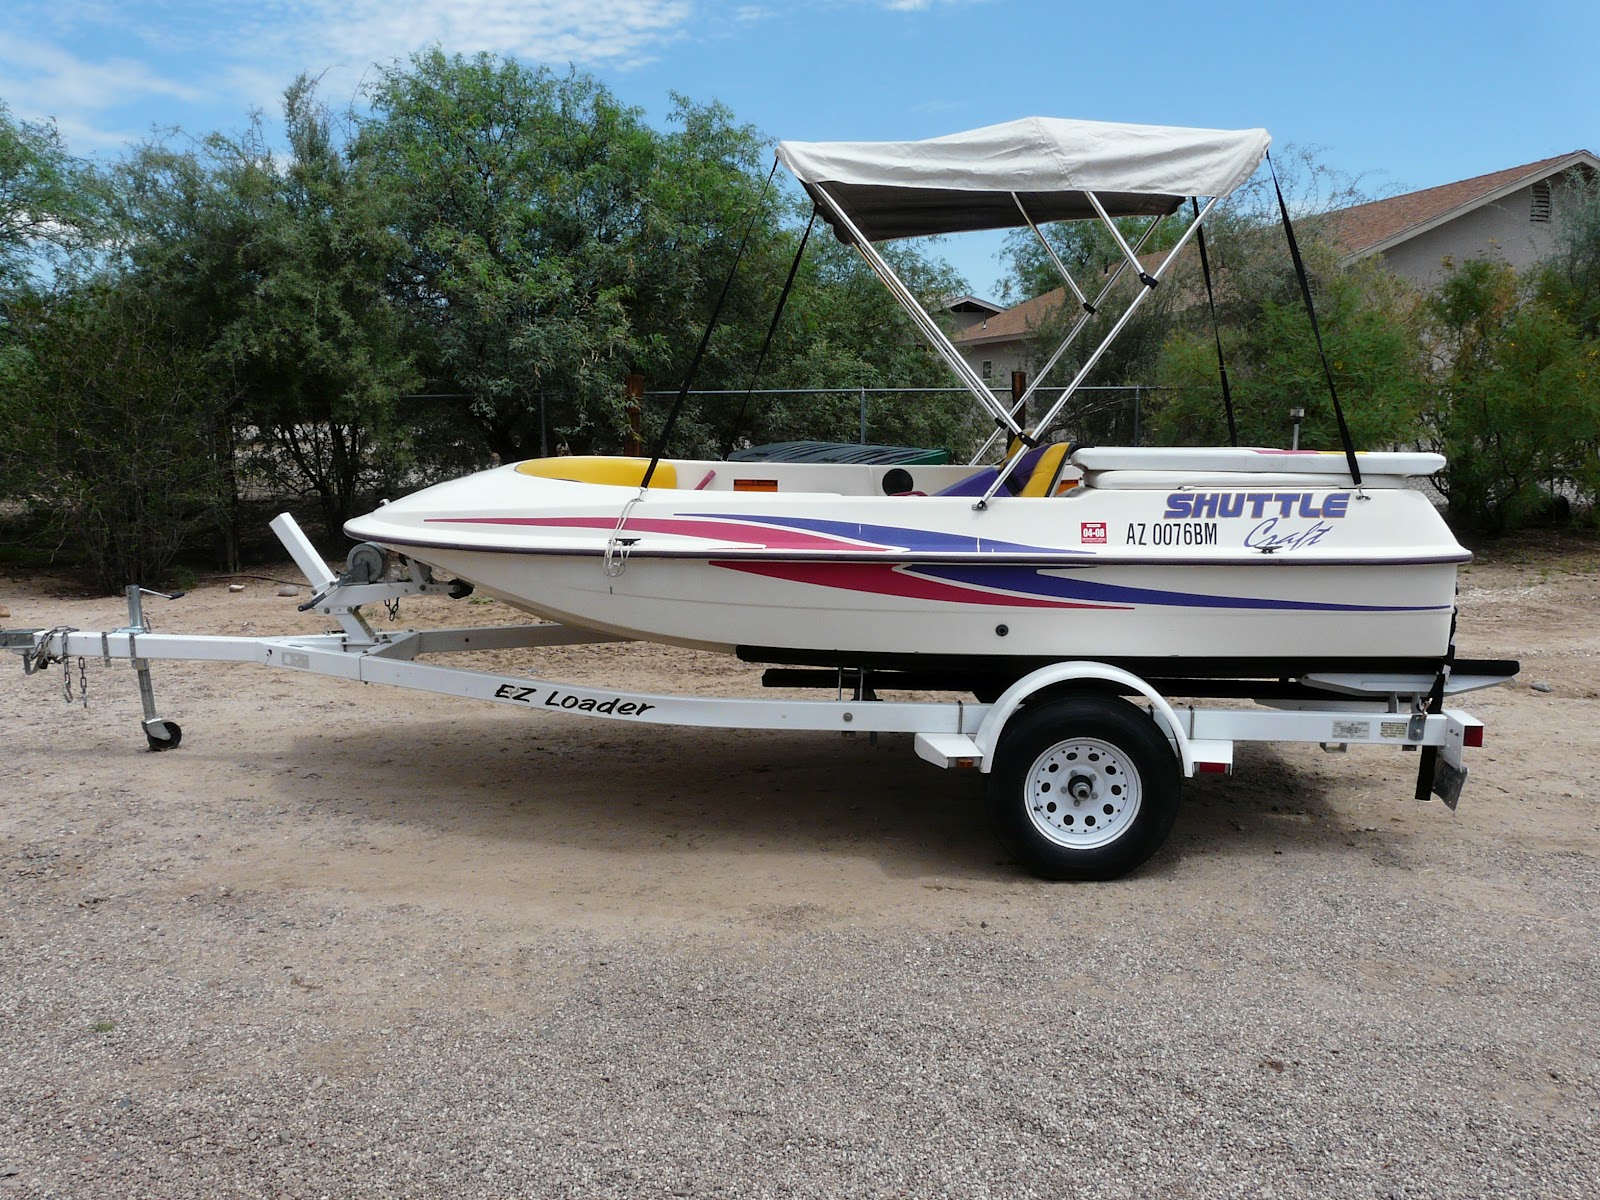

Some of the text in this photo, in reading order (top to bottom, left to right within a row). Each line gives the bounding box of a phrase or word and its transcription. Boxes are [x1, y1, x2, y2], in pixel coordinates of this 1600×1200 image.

[1163, 493, 1351, 519] SHUTTLE
[1126, 523, 1217, 546] AZ 0076BM
[1244, 517, 1334, 551] Craft
[494, 684, 656, 716] EZ Loader
